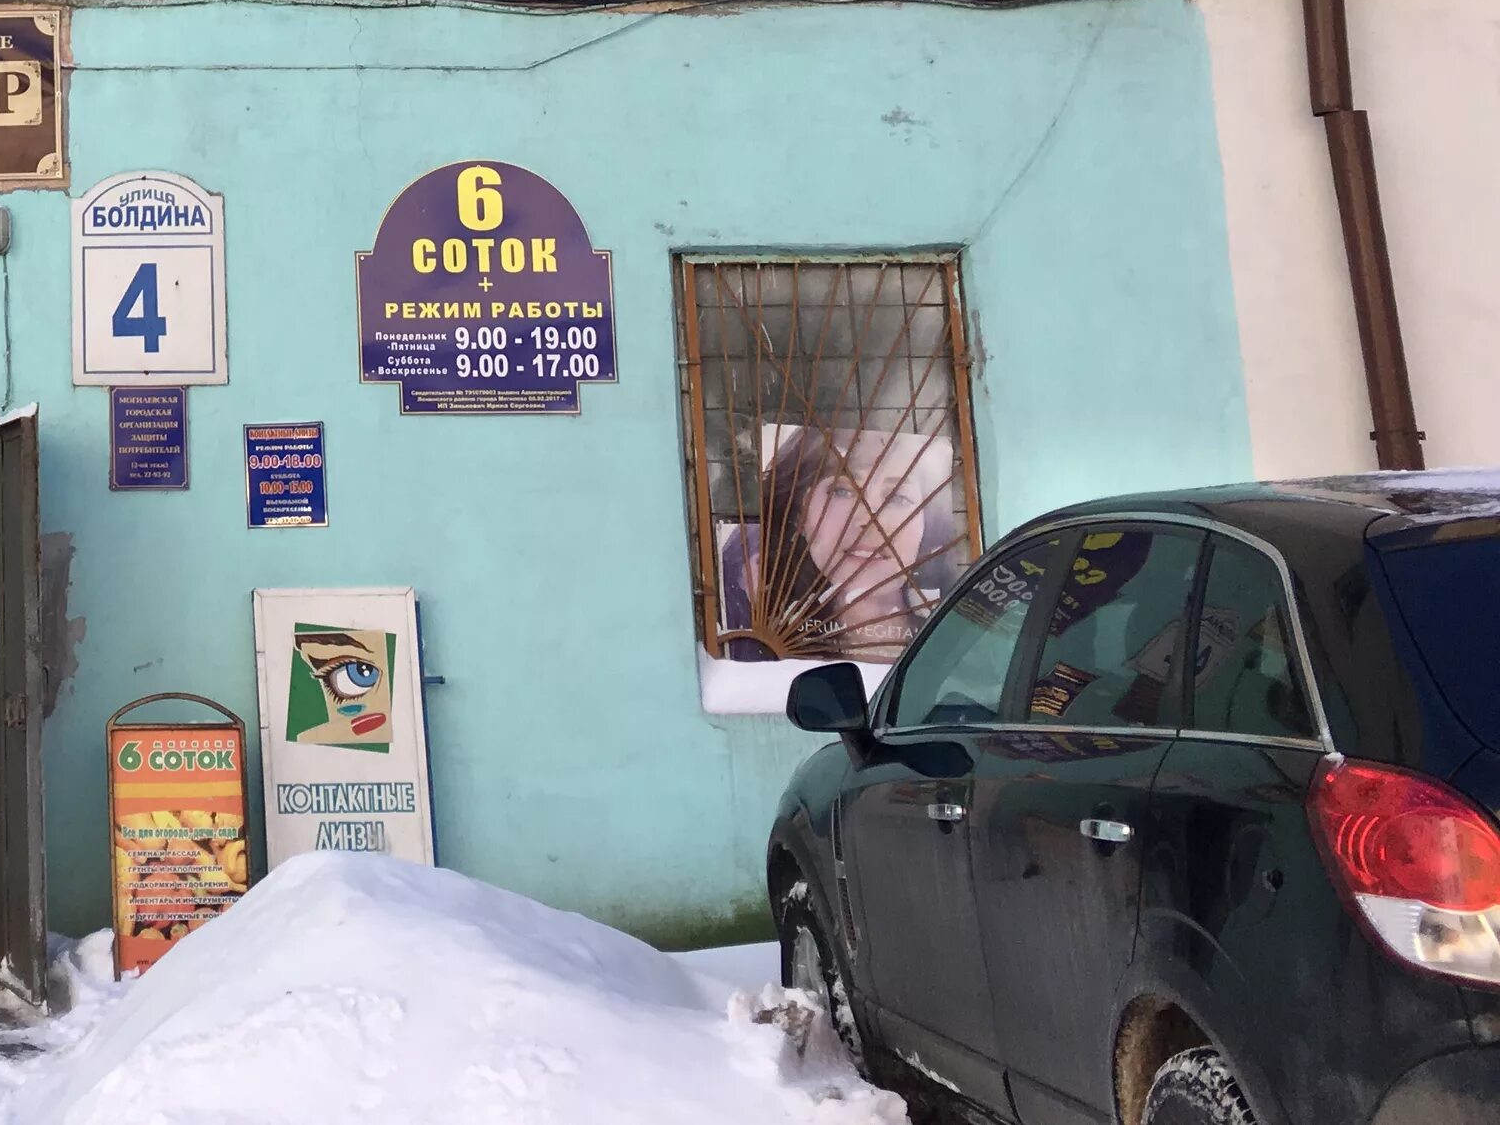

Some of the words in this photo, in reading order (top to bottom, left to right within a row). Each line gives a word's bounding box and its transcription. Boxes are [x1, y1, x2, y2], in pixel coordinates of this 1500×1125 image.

[118, 187, 176, 208] УЛИЦА
[457, 166, 504, 232] 6
[92, 205, 207, 232] БОЛДИНА
[412, 237, 558, 274] СОТОК
[112, 263, 168, 354] 4
[385, 302, 482, 319] РЕЖИМ
[491, 301, 603, 319] РАБОТЫ
[375, 332, 448, 343] Понедельник
[455, 326, 508, 350] 9.00
[530, 326, 597, 350] 19.00
[378, 366, 449, 377] Воскресенье
[387, 355, 431, 367] Суббота
[456, 353, 509, 378] 9.00
[532, 353, 600, 378] 17.00
[118, 740, 144, 772] 6
[148, 748, 237, 772] СОТОК
[277, 781, 416, 815] КОНТАКТНЫЕ
[315, 821, 387, 852] ЛИНЗЫ
